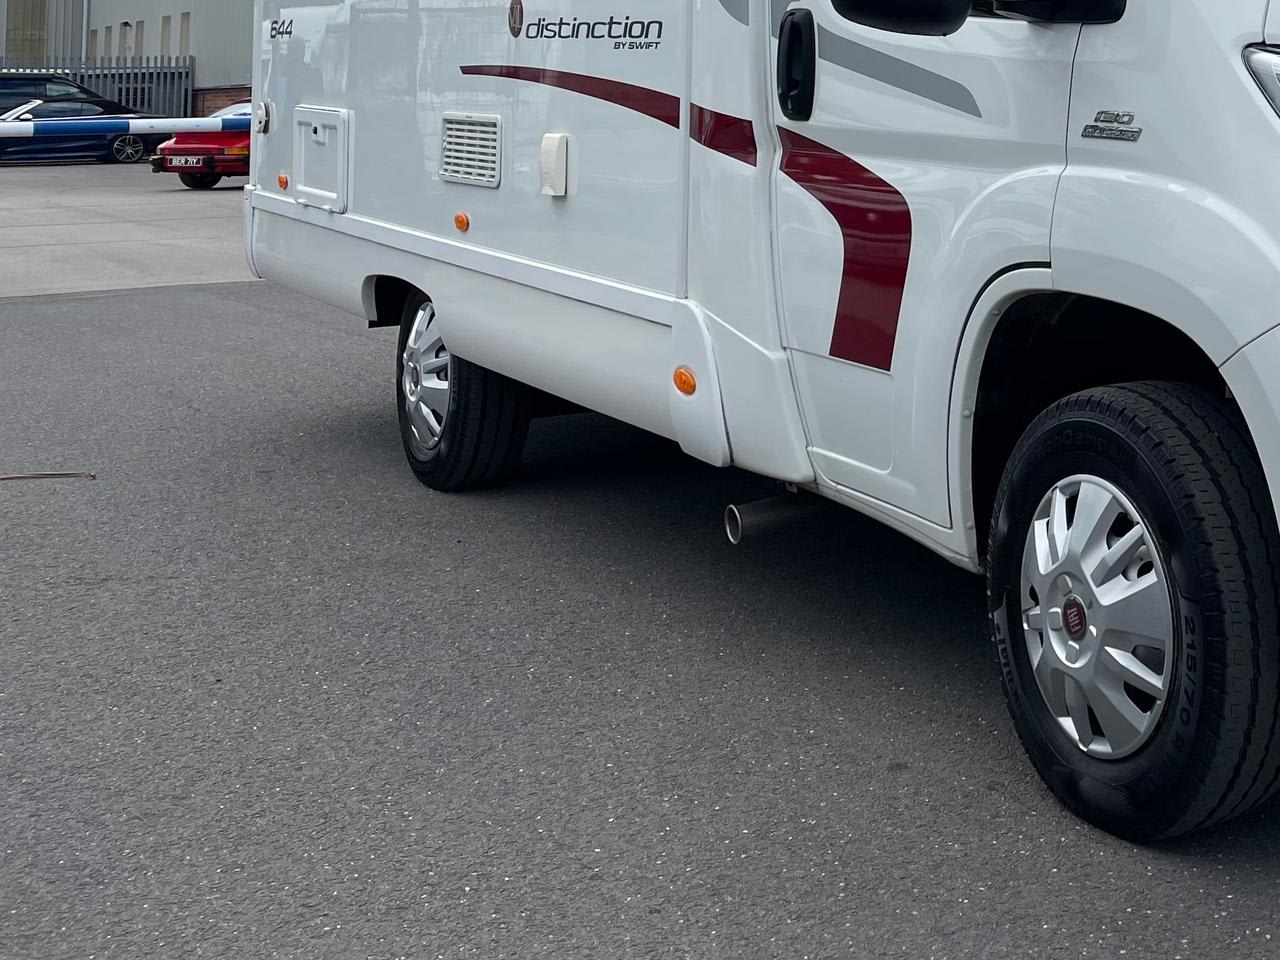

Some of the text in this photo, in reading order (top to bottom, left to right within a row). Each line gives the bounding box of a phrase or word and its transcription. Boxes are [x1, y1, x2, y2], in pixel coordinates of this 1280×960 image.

[270, 19, 293, 39] 644
[525, 15, 663, 39] distinction
[613, 41, 661, 50] BY SWIFT
[1067, 607, 1081, 633] FIAT
[1179, 614, 1199, 727] 215/70
